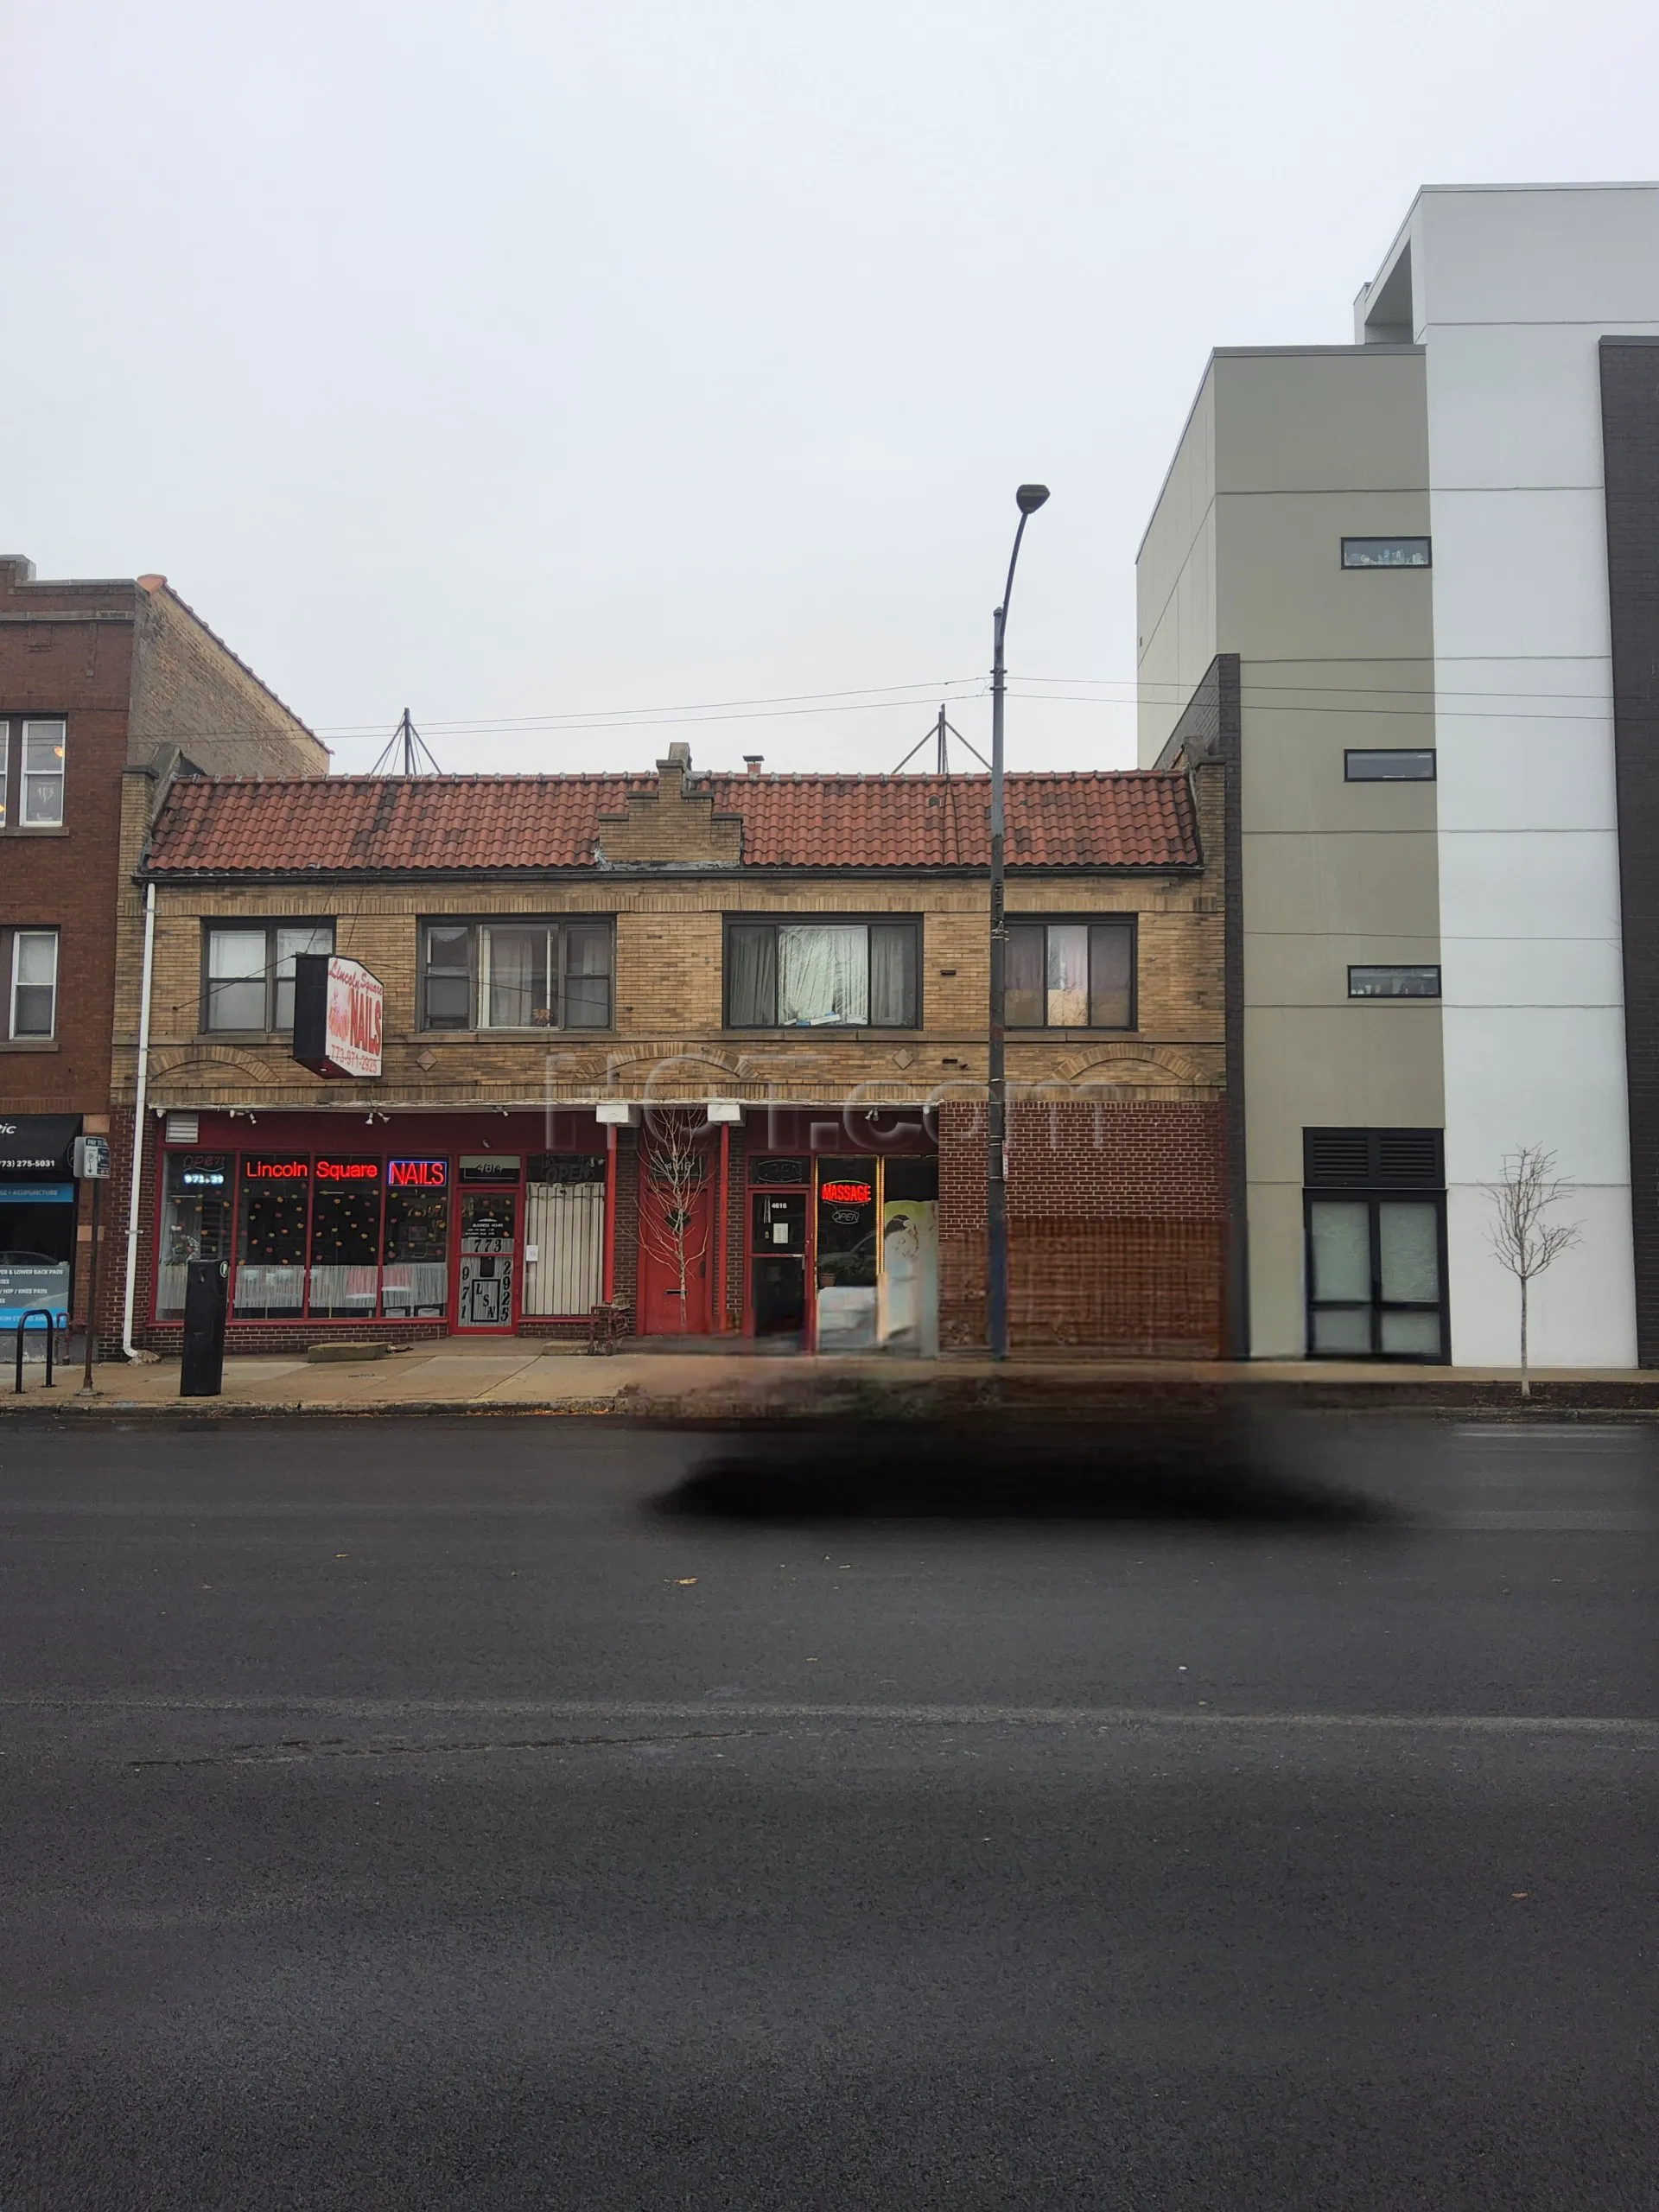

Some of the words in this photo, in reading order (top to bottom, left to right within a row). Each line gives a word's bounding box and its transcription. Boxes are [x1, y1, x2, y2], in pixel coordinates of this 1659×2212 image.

[328, 957, 360, 989] Lincoln
[360, 972, 384, 995] Square
[349, 988, 381, 1057] NAILS
[331, 1044, 378, 1074] 773-971-2925
[246, 1160, 308, 1178] Lincoln
[316, 1161, 378, 1180] Square
[391, 1162, 444, 1185] NAILS
[822, 1185, 871, 1201] MASSAGE
[832, 1211, 860, 1221] OPEN
